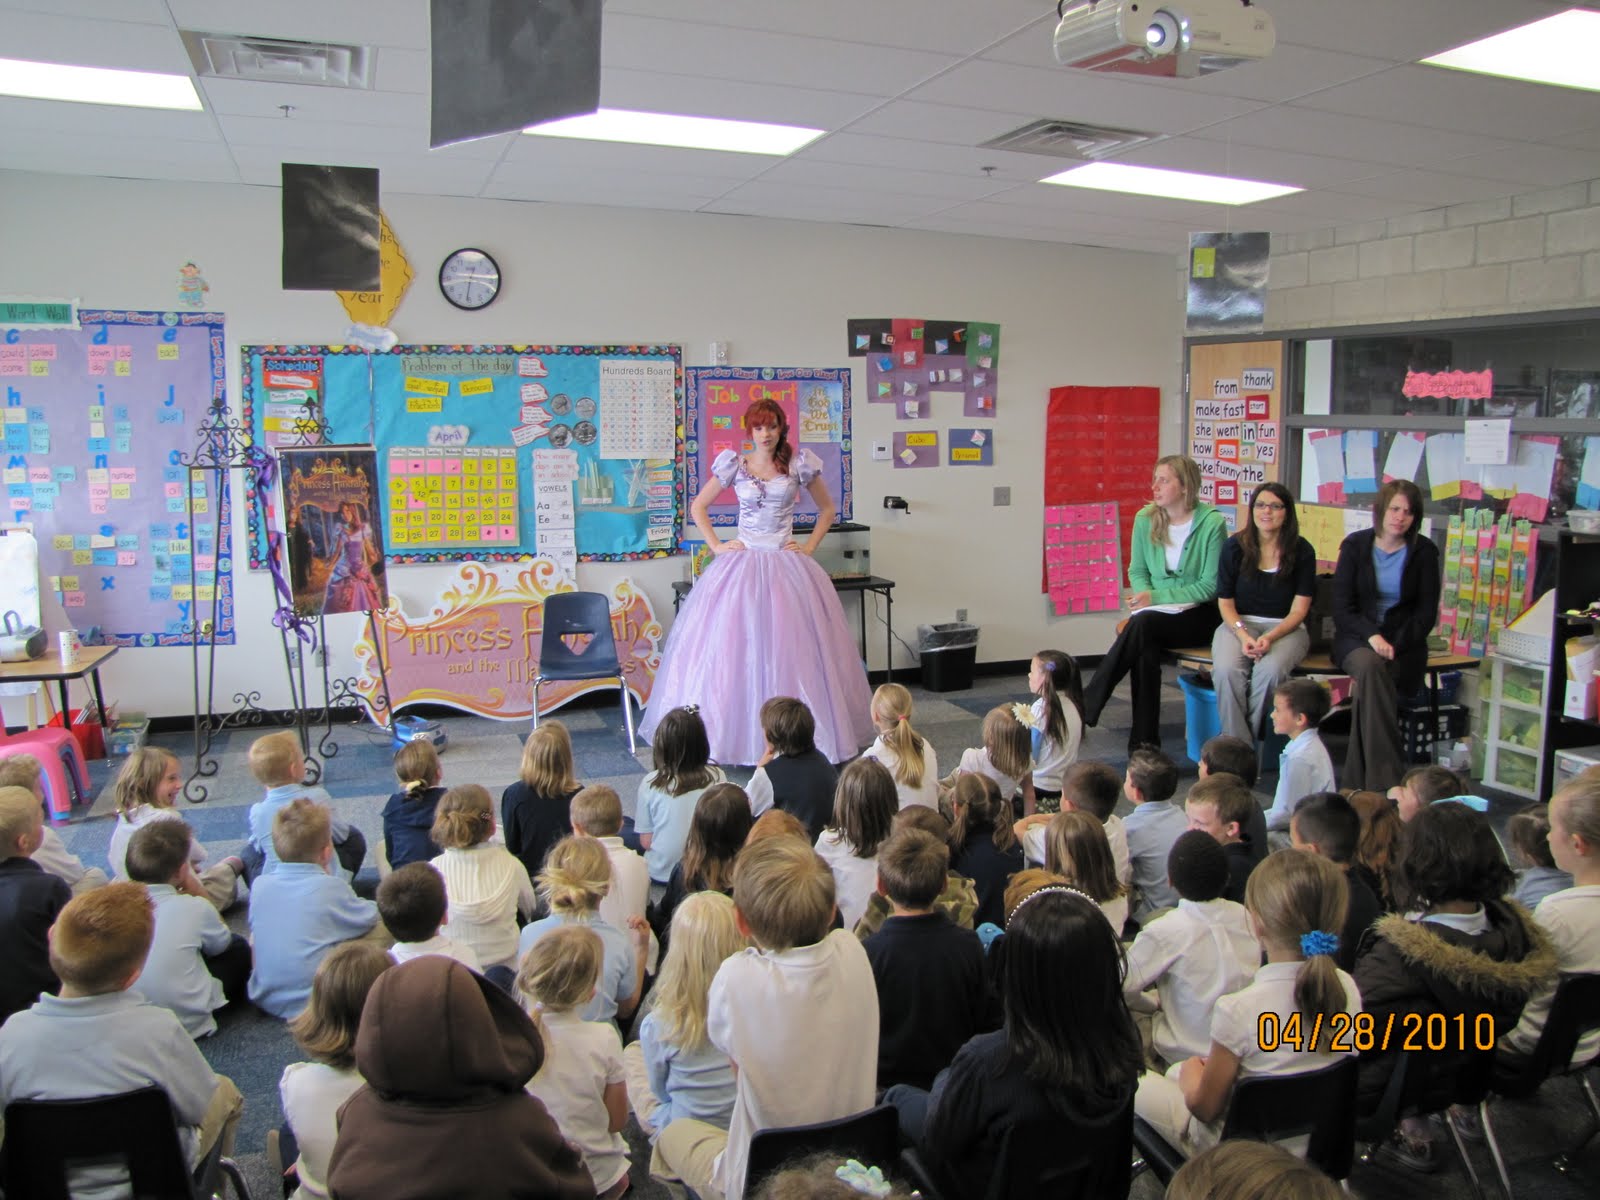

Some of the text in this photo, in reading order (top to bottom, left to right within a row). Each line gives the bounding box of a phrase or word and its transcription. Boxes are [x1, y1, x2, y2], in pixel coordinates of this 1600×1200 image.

[7, 303, 69, 321] Word Wall
[92, 325, 108, 345] d
[162, 328, 178, 342] e
[267, 360, 319, 371] Schedule
[402, 357, 446, 373] Problem
[471, 358, 489, 371] the
[493, 357, 511, 375] day
[602, 366, 672, 376] Hundreds Board
[714, 368, 731, 377] Our
[777, 369, 793, 379] Love
[795, 368, 813, 378] Our
[1244, 373, 1272, 387] thank
[708, 382, 798, 404] Job Chart
[1214, 380, 1238, 395] from
[8, 386, 21, 406] h
[1195, 403, 1245, 418] make fast
[804, 420, 838, 432] Trust
[1195, 421, 1275, 440] she went in fun
[435, 431, 462, 444] April
[1193, 440, 1213, 455] how
[1256, 445, 1274, 459] yes
[95, 454, 107, 468] n
[1215, 460, 1264, 482] funny the
[537, 501, 550, 510] Aa
[538, 515, 550, 524] Ee
[175, 522, 188, 539] t
[651, 527, 670, 535] Friday
[540, 534, 547, 544] Ii
[101, 576, 115, 591] x
[178, 601, 190, 620] y
[377, 615, 513, 672] Princess
[448, 658, 473, 675] and
[478, 659, 500, 673] the
